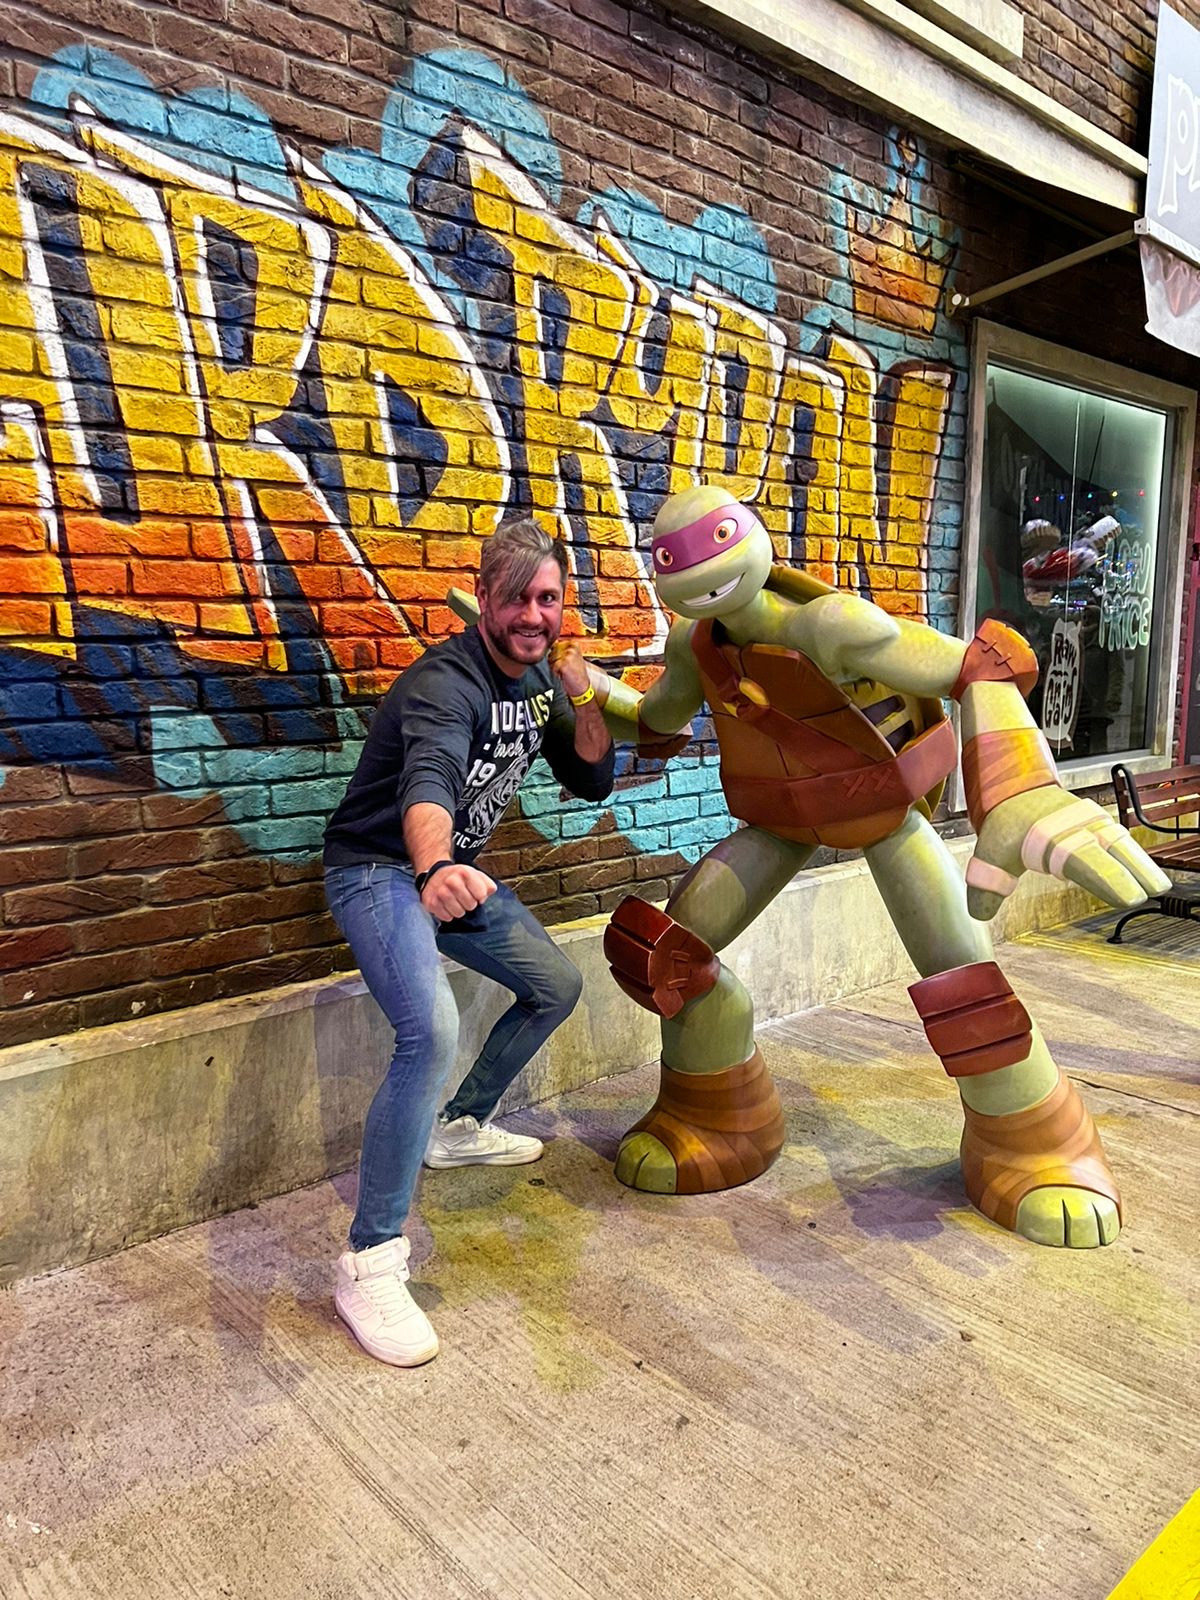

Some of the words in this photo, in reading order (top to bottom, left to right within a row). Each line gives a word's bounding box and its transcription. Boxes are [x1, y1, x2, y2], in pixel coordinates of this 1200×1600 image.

[1158, 72, 1200, 217] P
[1103, 538, 1151, 595] LOW
[1053, 632, 1077, 667] Raw
[1098, 593, 1151, 652] PRICE
[465, 759, 496, 788] 19
